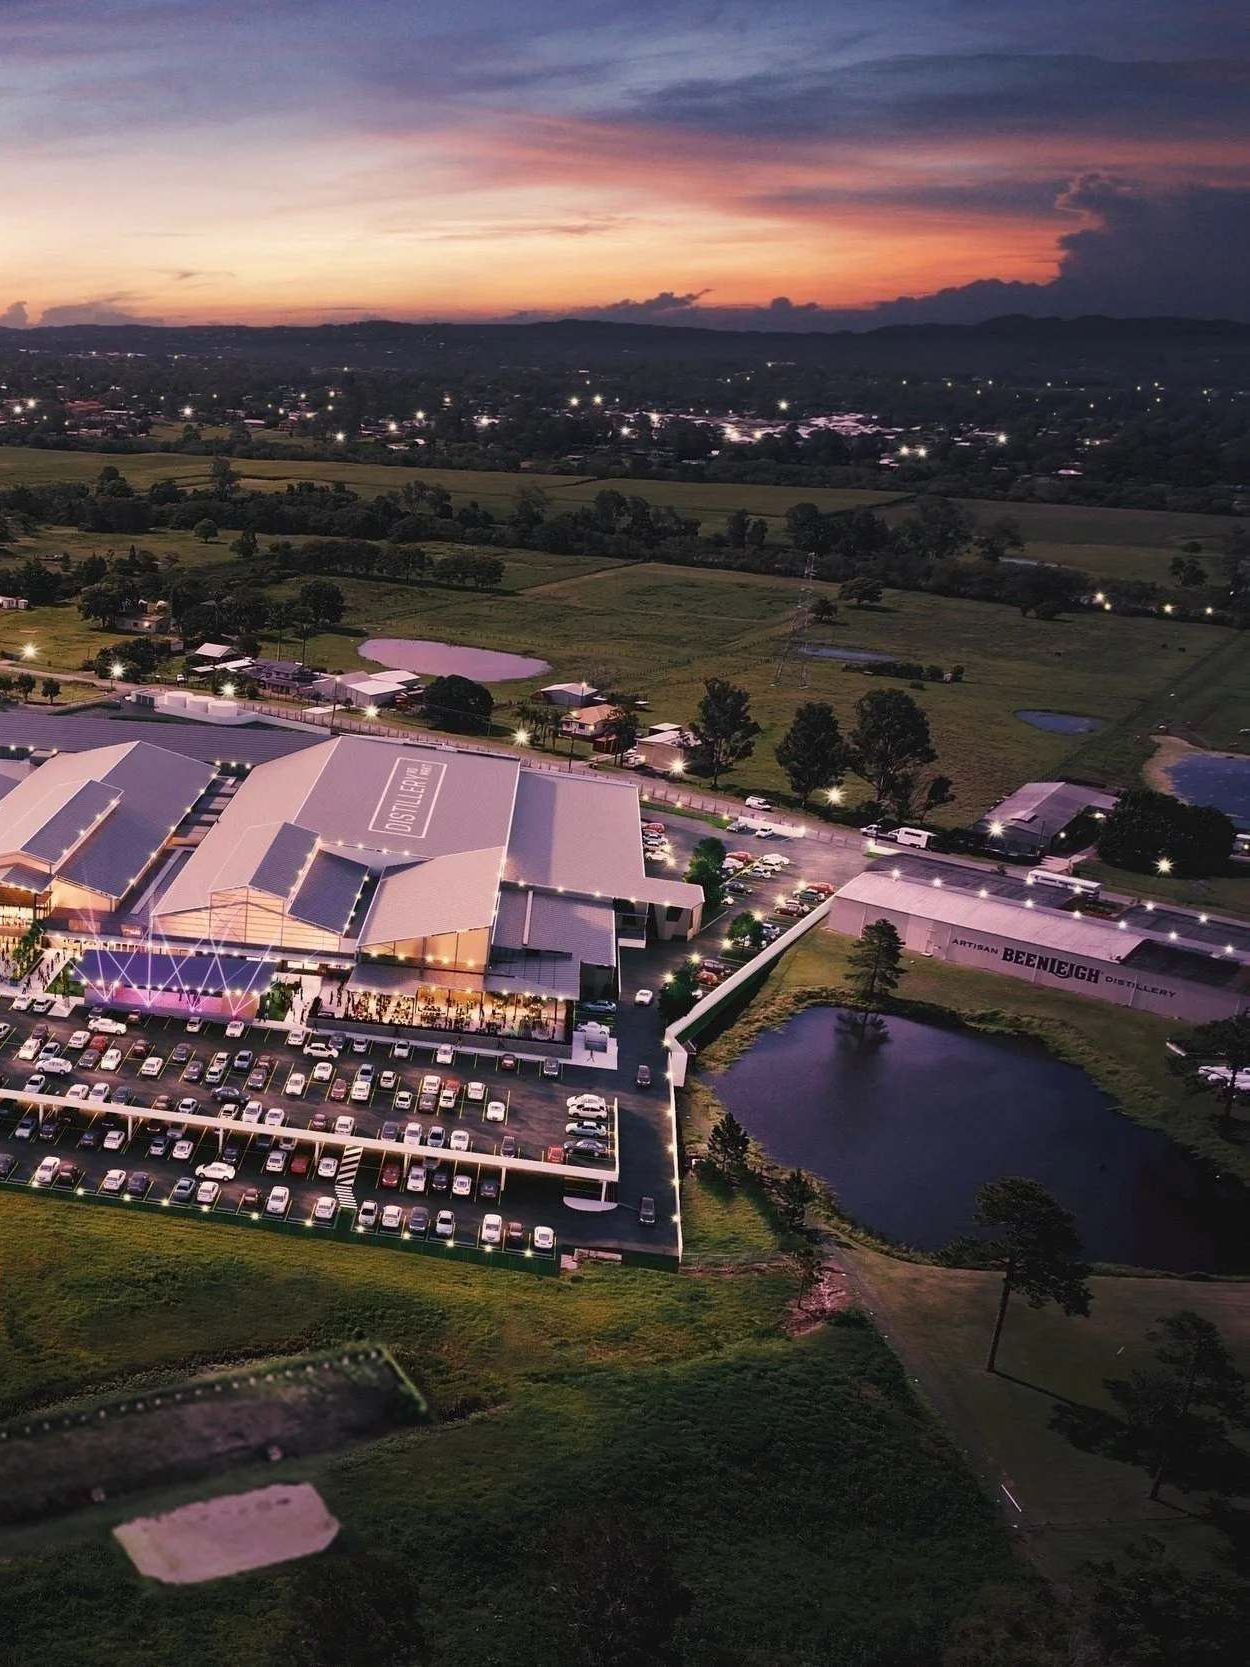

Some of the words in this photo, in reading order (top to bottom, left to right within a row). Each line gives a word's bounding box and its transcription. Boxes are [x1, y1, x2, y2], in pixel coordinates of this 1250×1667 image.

[385, 773, 428, 832] DISTILLERY
[951, 938, 999, 955] ARTISAN
[1001, 946, 1101, 985] BEENLEIGH
[1105, 975, 1177, 999] DISTILLERY
